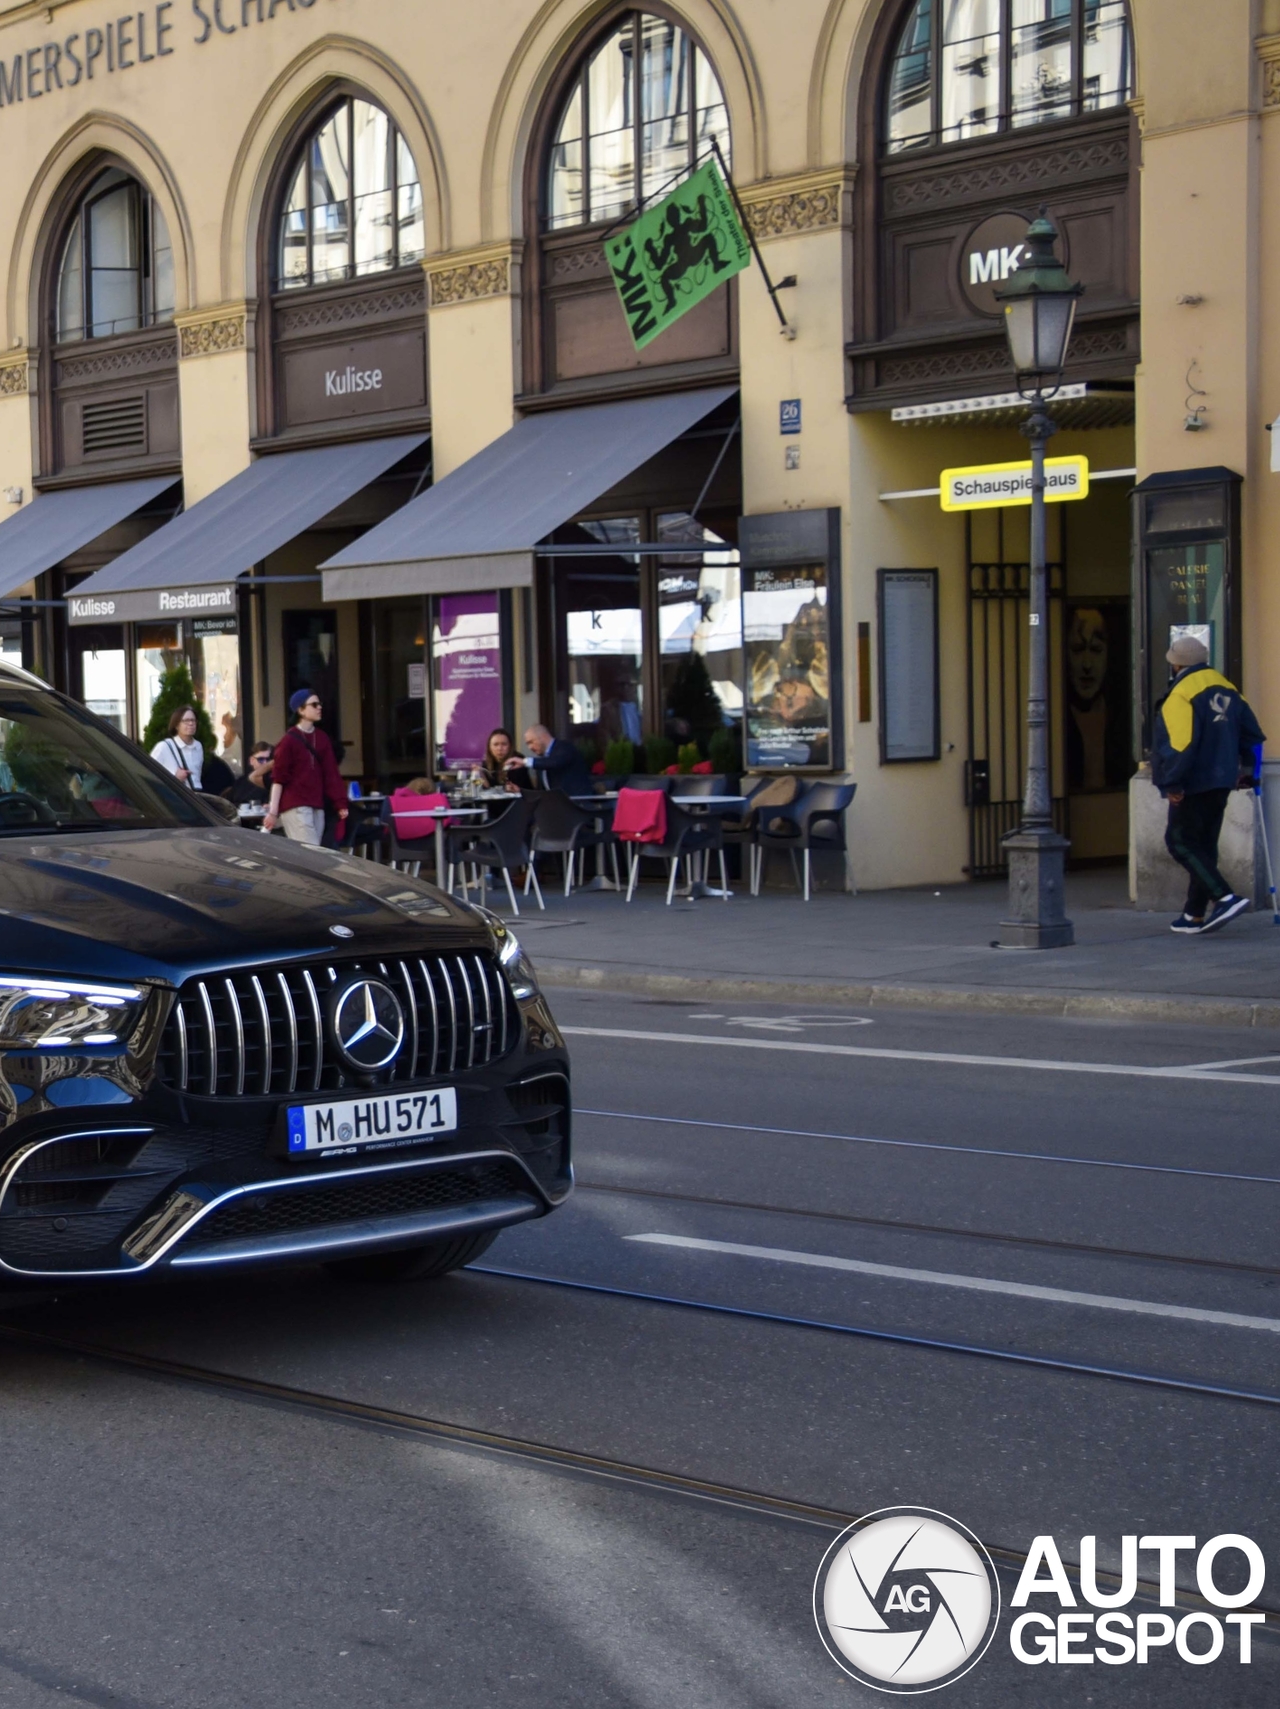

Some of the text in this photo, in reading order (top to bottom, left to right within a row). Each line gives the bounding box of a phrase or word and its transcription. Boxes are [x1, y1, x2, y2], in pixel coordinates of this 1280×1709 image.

[613, 236, 658, 342] MK:
[324, 366, 383, 397] Kulisse
[782, 402, 798, 419] 26
[953, 472, 1077, 497] Schauspieaus
[72, 587, 232, 618] Kulisse Restaurant
[294, 1093, 446, 1144] D M HU 571
[365, 1142, 396, 1151] PERFORMANCE
[396, 1139, 412, 1147] CENTER
